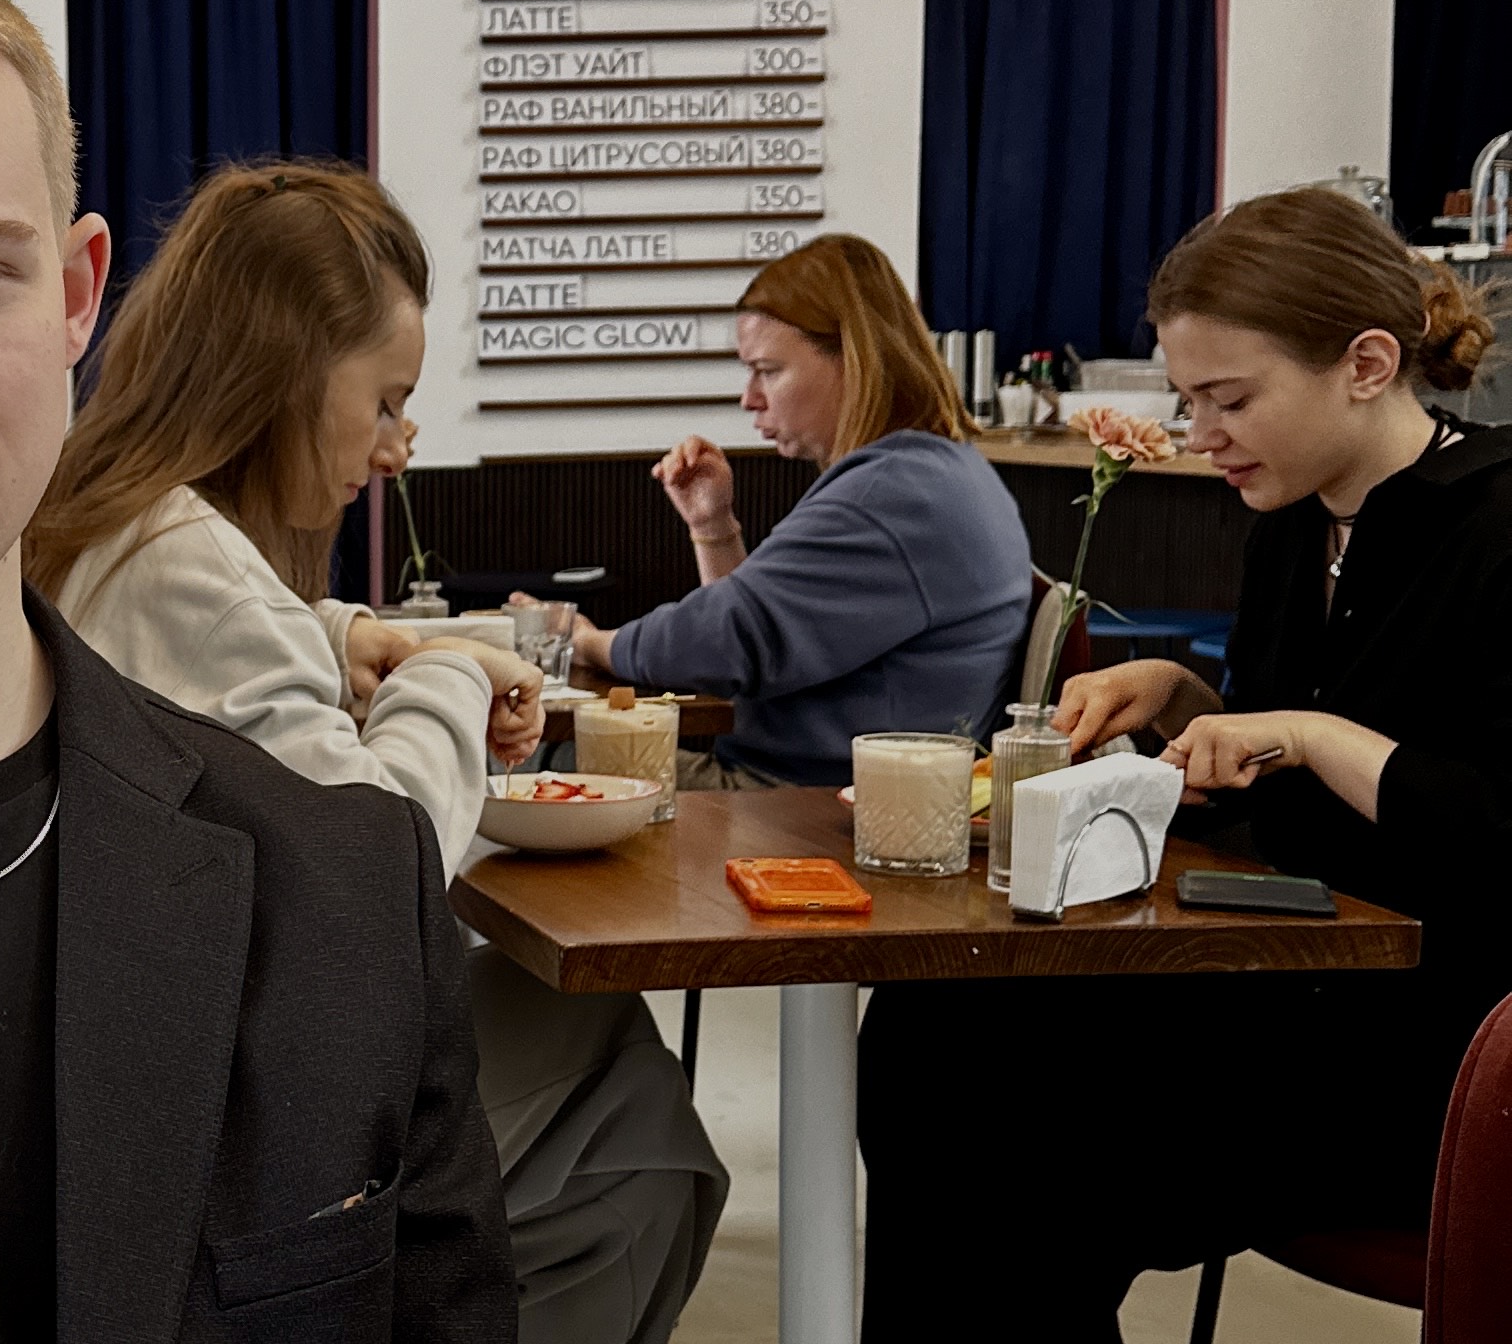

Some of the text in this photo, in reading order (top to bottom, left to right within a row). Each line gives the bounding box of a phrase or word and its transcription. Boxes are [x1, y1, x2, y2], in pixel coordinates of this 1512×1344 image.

[488, 6, 573, 31] ЛАТТЕ
[484, 53, 565, 78] ФЛЭТ
[573, 47, 644, 75] УАЙТ
[484, 99, 544, 122] РАФ
[551, 90, 729, 121] ВАНИЛЬНЫЙ
[482, 146, 543, 169] РАФ
[550, 136, 745, 172] ЦИТРУСОВЫЙ
[485, 190, 577, 213] КАКАО
[483, 237, 577, 260] МАТЧА
[584, 234, 668, 258] ЛАТТЕ
[483, 283, 578, 308] ЛАТТЕ
[483, 321, 693, 350] MAGIC GLOW
